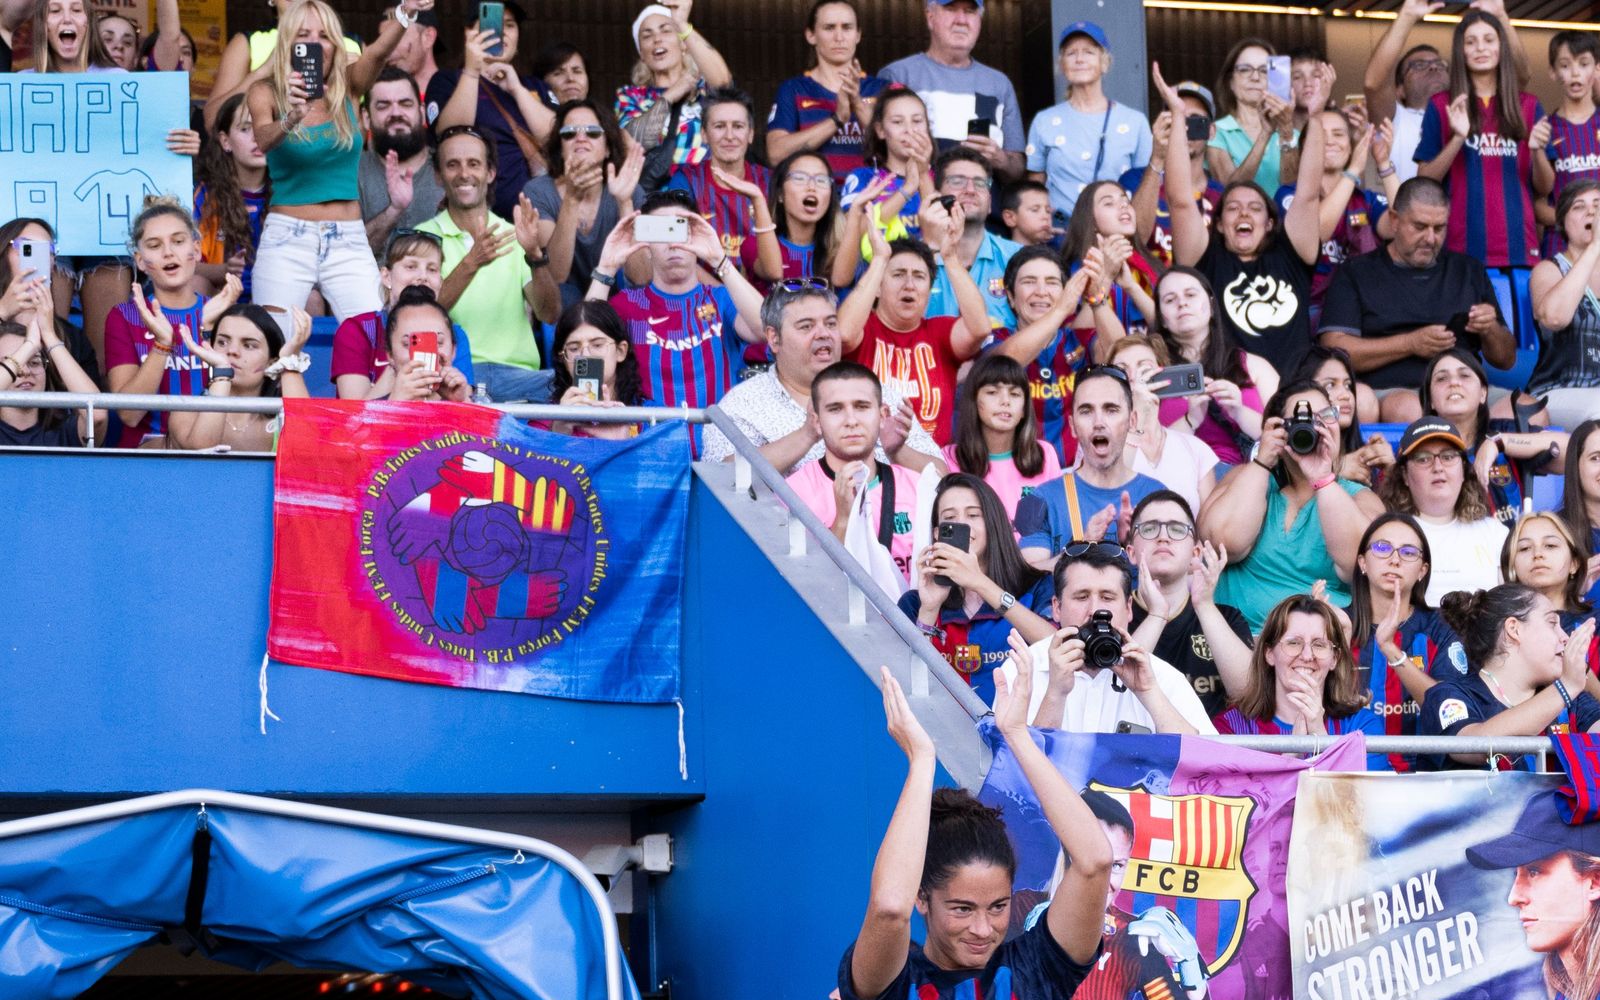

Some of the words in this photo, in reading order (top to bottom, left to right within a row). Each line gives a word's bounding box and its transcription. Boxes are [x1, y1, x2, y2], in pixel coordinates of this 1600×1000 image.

[0, 81, 139, 154] APi
[830, 135, 864, 144] AIRWA
[1478, 147, 1517, 157] AIRWAYS
[646, 323, 722, 351] STANLEY
[1030, 373, 1076, 399] nicef
[422, 430, 477, 455] Unides
[360, 510, 374, 556] Força
[361, 560, 391, 602] FEM
[590, 537, 610, 593] Unides
[390, 602, 437, 646] Unides
[562, 595, 596, 633] FEM
[519, 629, 563, 661] Força
[1136, 864, 1200, 894] FCB
[1303, 898, 1370, 963] COME
[1373, 869, 1444, 935] BACK
